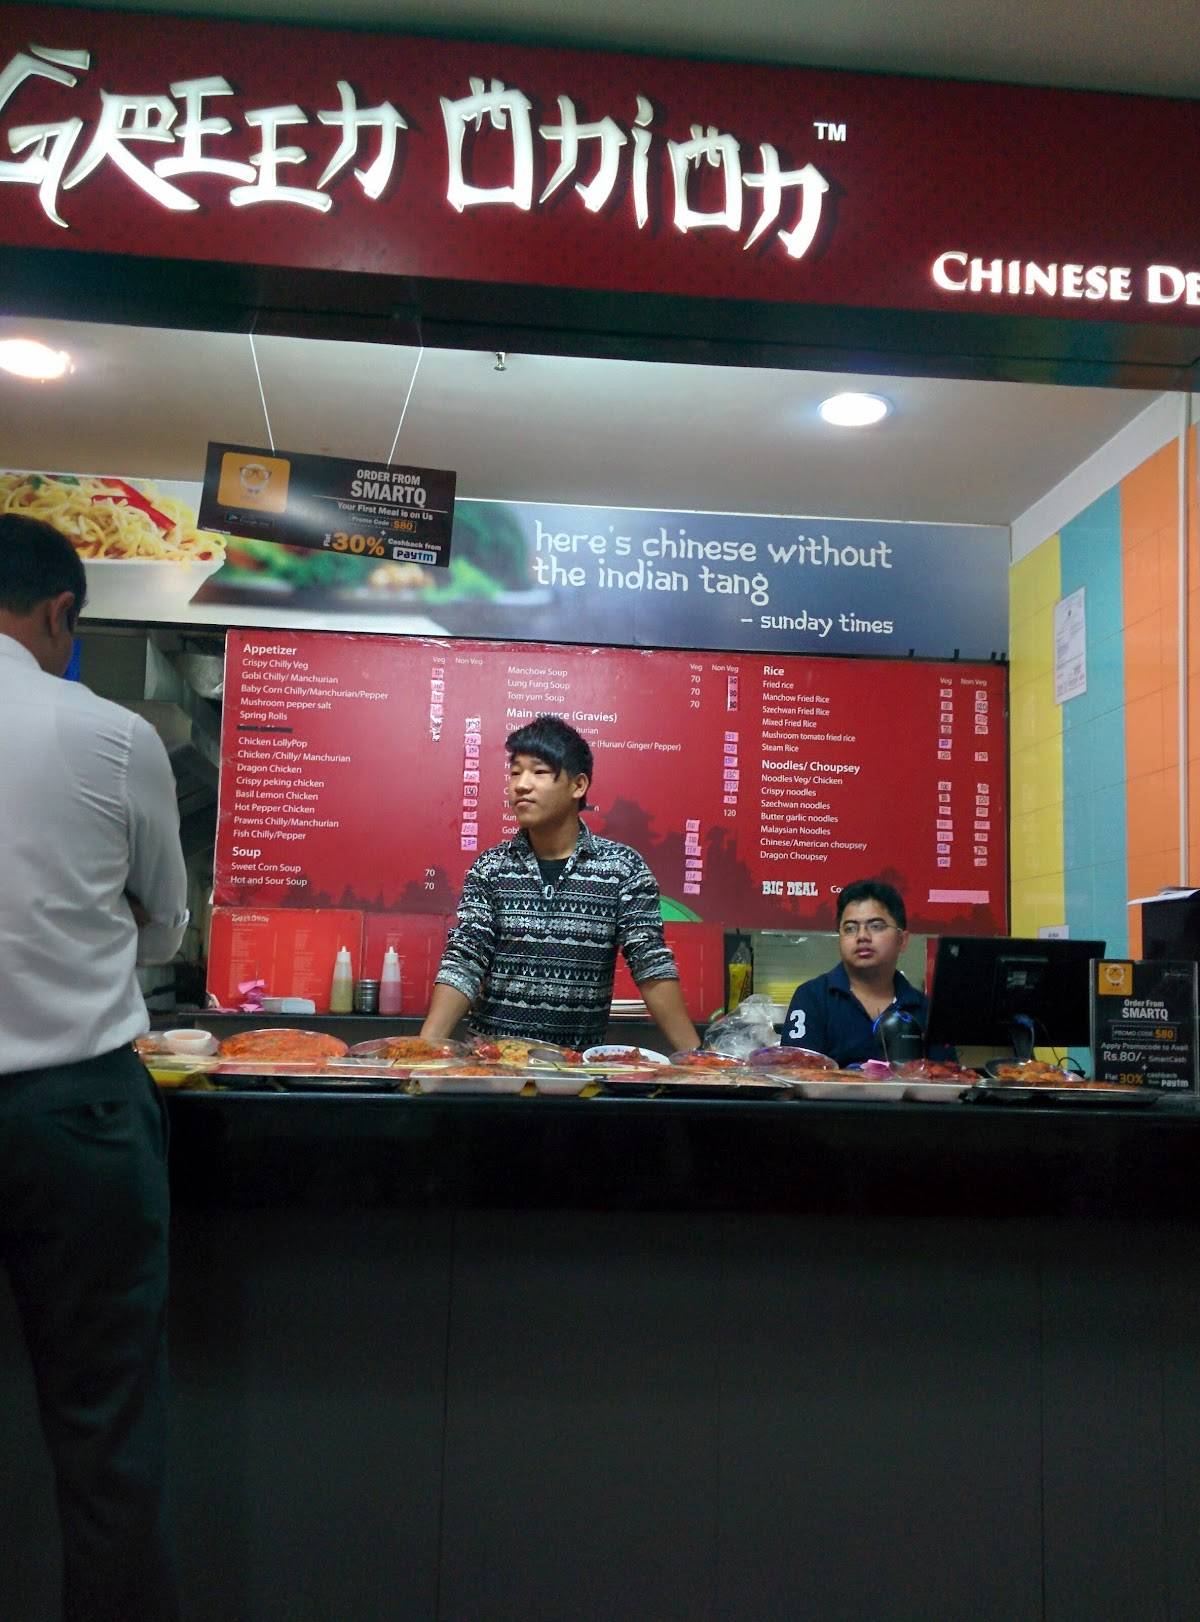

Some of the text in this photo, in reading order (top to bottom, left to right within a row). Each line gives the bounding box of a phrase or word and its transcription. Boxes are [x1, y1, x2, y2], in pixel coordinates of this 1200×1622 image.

[814, 122, 847, 142] TM
[932, 250, 1132, 301] CHINESE
[357, 470, 420, 485] ORDER FROM
[351, 480, 426, 508] SMARTQ
[337, 502, 356, 510] Your
[358, 505, 377, 513] First
[378, 508, 399, 516] Meal
[332, 532, 384, 556] 30%
[388, 538, 441, 550] Cashback from
[535, 520, 893, 569] here's chinese without
[532, 556, 769, 606] the indian tang
[760, 610, 893, 637] sunday times
[243, 644, 297, 655] Appetizer
[242, 659, 308, 670] Crispy Chilly Veg
[469, 658, 483, 666] Veg
[690, 663, 702, 672] Veg
[508, 666, 568, 678] Manchow Soup
[726, 665, 739, 673] Veg
[763, 666, 784, 676] Rice
[242, 672, 338, 684] Gobi Chilly/ Manchurian
[508, 679, 570, 690] Lung Fung Soup
[241, 685, 261, 694] Baby
[284, 687, 388, 700] Chilly/Manchurian/Pepper
[545, 694, 564, 702] Soup
[763, 693, 795, 701] Manchow
[240, 698, 284, 707] Mushroom
[287, 702, 315, 710] pepper
[507, 708, 532, 718] Main
[572, 711, 617, 723] (Gravies)
[763, 706, 796, 714] Szechwan
[240, 711, 287, 721] Spring Rolls
[785, 719, 801, 727] Fried
[803, 720, 816, 728] Rice
[762, 731, 798, 739] Mushroom
[239, 737, 271, 746] Chicken
[627, 741, 681, 751] Ginger/ Pepper)
[785, 744, 799, 752] Rice
[237, 750, 270, 759] Chicken
[303, 753, 350, 762] Manchurian
[237, 763, 302, 773] Dragon Chicken
[762, 760, 860, 775] Noodles/ Choupsey
[236, 777, 324, 787] Crispy peking chicken
[762, 774, 842, 785] Noodles Veg/ Chicken
[236, 790, 318, 800] Basil Lemon Chicken
[761, 787, 784, 796] Crispy
[252, 804, 280, 813] Pepper
[282, 805, 315, 813] Chicken
[761, 800, 798, 808] Szechwan
[234, 817, 339, 828] Prawns Chilly/Manchurian
[786, 814, 806, 822] garlic
[233, 830, 306, 840] Fish Chilly/Pepper
[761, 826, 830, 835] Malaysian Noodles
[760, 838, 867, 851] Chinese/American choupsey
[232, 846, 261, 858] Soup
[760, 851, 827, 862] Dragon Choupsey
[232, 862, 301, 873] Sweet Corn Soup
[231, 876, 246, 884] Hot
[265, 877, 284, 885] Sour
[287, 878, 307, 887] Soup
[424, 882, 435, 890] 70
[762, 881, 818, 896] BIG DEAL
[1124, 999, 1144, 1007] Order
[1122, 1008, 1168, 1021] SMARTQ
[789, 1010, 806, 1039] 3
[1119, 1073, 1143, 1084] 30%
